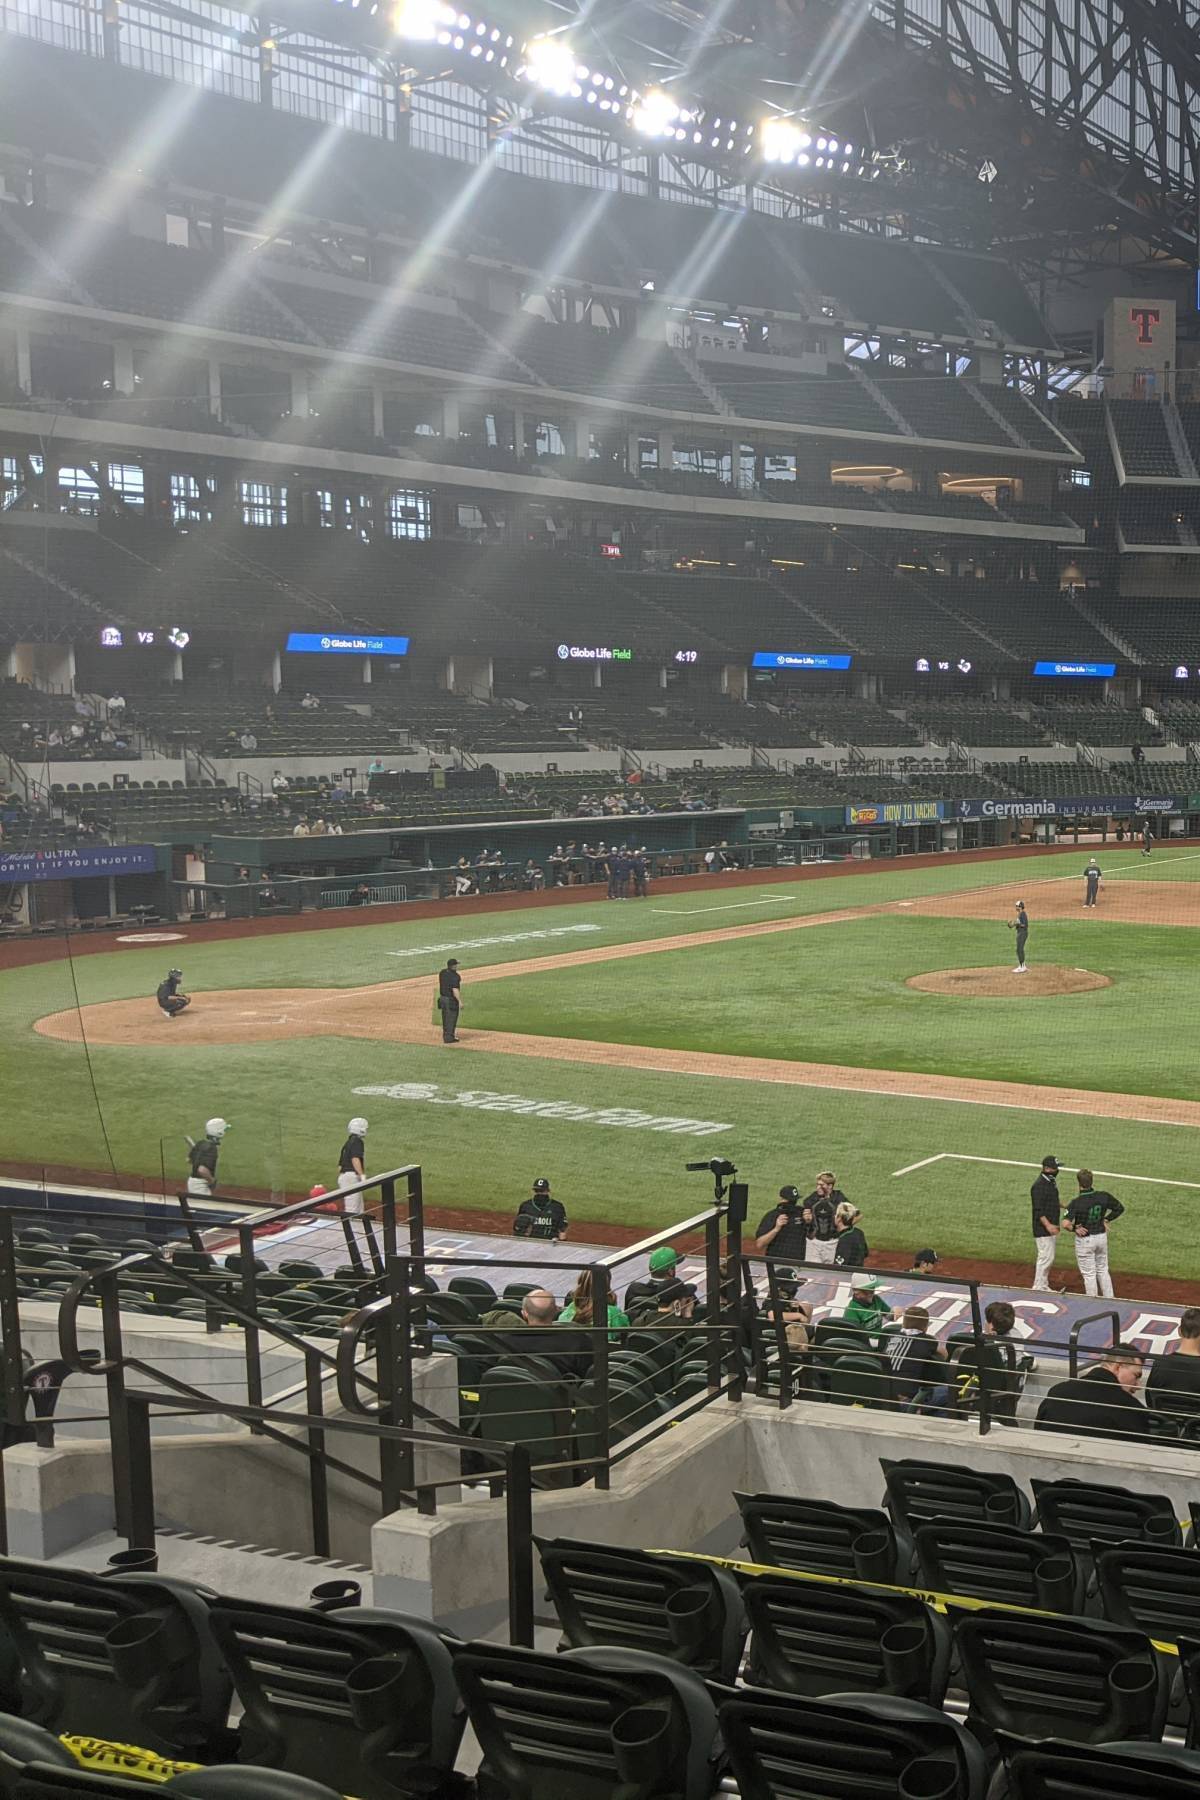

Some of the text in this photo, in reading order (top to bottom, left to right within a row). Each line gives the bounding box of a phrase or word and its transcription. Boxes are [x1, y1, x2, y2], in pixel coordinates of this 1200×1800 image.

[1130, 308, 1160, 345] T
[138, 632, 154, 643] VS
[331, 640, 352, 648] Globe
[353, 640, 366, 648] Life
[570, 647, 631, 659] Globe Life Field
[675, 651, 697, 662] 4:19
[802, 657, 814, 665] Life
[884, 806, 902, 820] HOW
[904, 804, 912, 820] TO
[982, 799, 1056, 815] Germania
[1058, 805, 1117, 813] INSURANCE
[44, 850, 78, 859] ULTRA
[36, 862, 46, 870] IT
[94, 857, 128, 866] ENJOY
